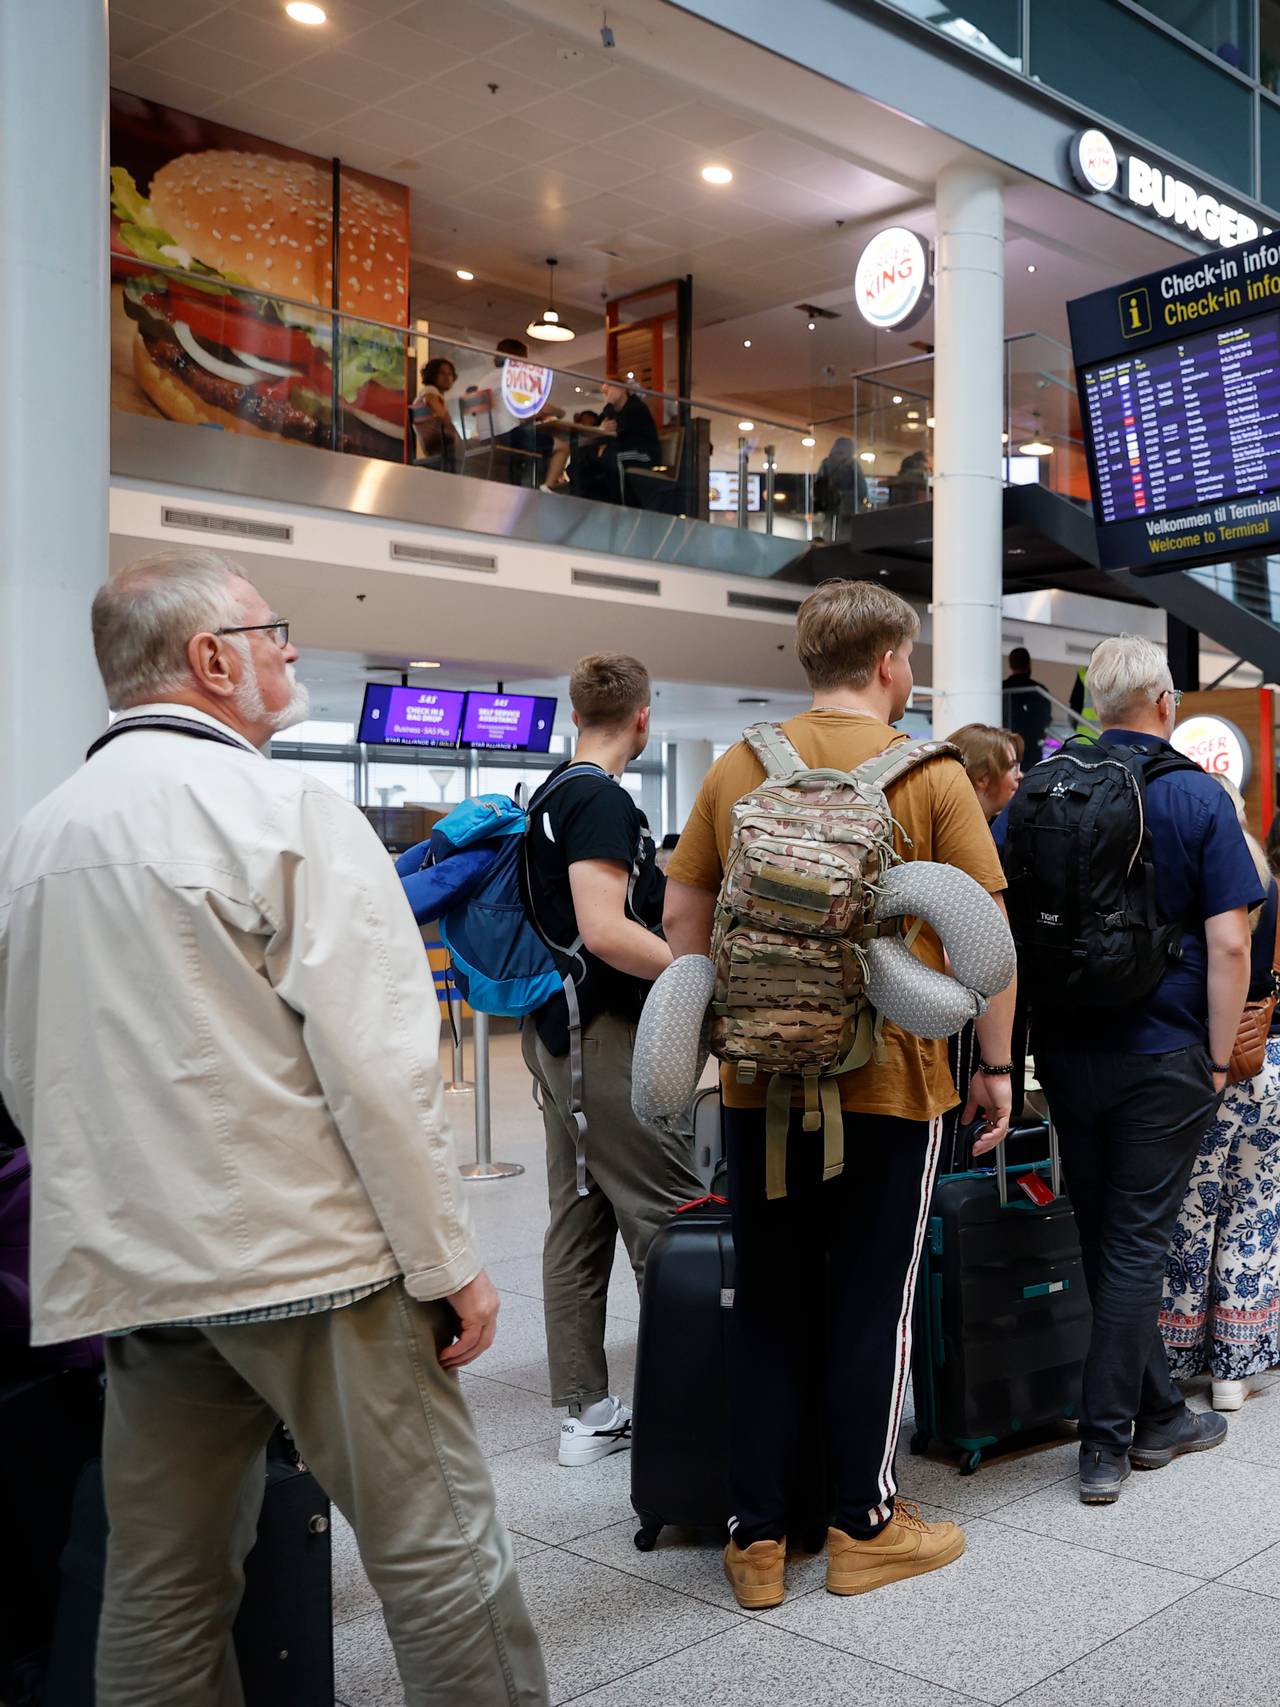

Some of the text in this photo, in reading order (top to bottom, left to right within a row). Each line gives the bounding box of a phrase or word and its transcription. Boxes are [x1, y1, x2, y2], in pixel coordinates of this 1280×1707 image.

[1161, 258, 1238, 299] Check-in
[1164, 287, 1241, 326] Check-in
[1146, 512, 1212, 536] Velkommen
[1214, 507, 1226, 523] til
[1229, 496, 1280, 520] Terminal
[1149, 518, 1270, 553] Welcome to Terminal
[371, 708, 380, 720] 8
[538, 719, 545, 730] 9
[1185, 736, 1227, 757] RGER
[1040, 911, 1060, 923] TIGHT
